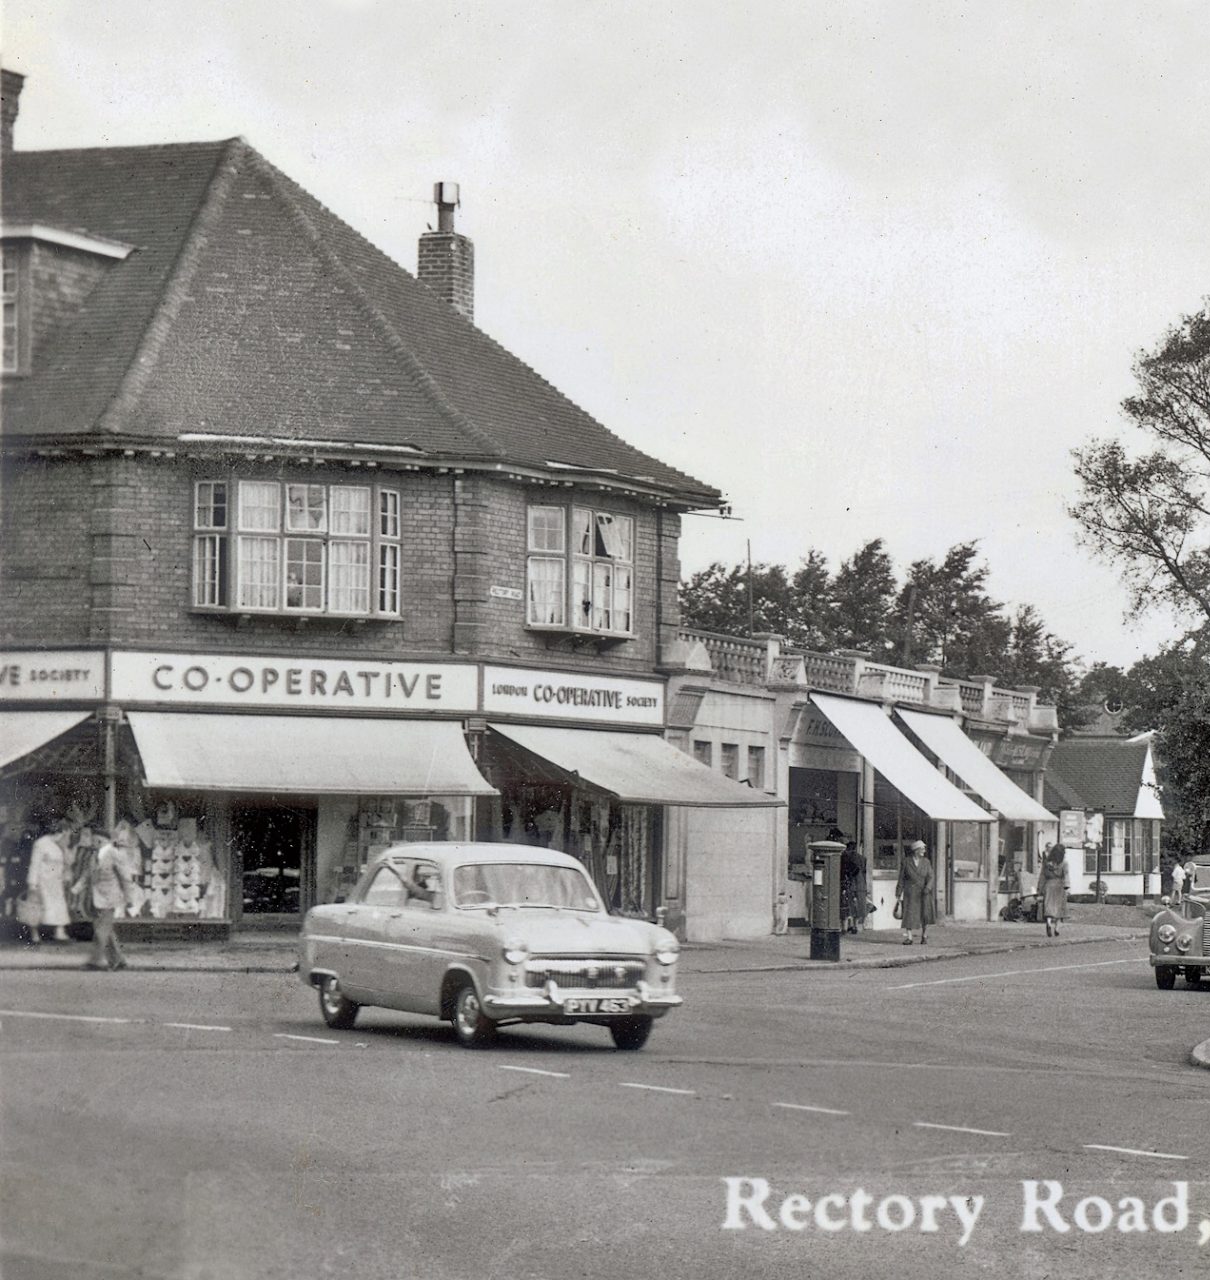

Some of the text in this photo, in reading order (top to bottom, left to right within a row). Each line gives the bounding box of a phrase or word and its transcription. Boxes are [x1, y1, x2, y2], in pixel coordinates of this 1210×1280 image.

[30, 669, 90, 682] SOCIETY
[493, 683, 528, 696] LONDON
[626, 696, 657, 708] SOCIETY
